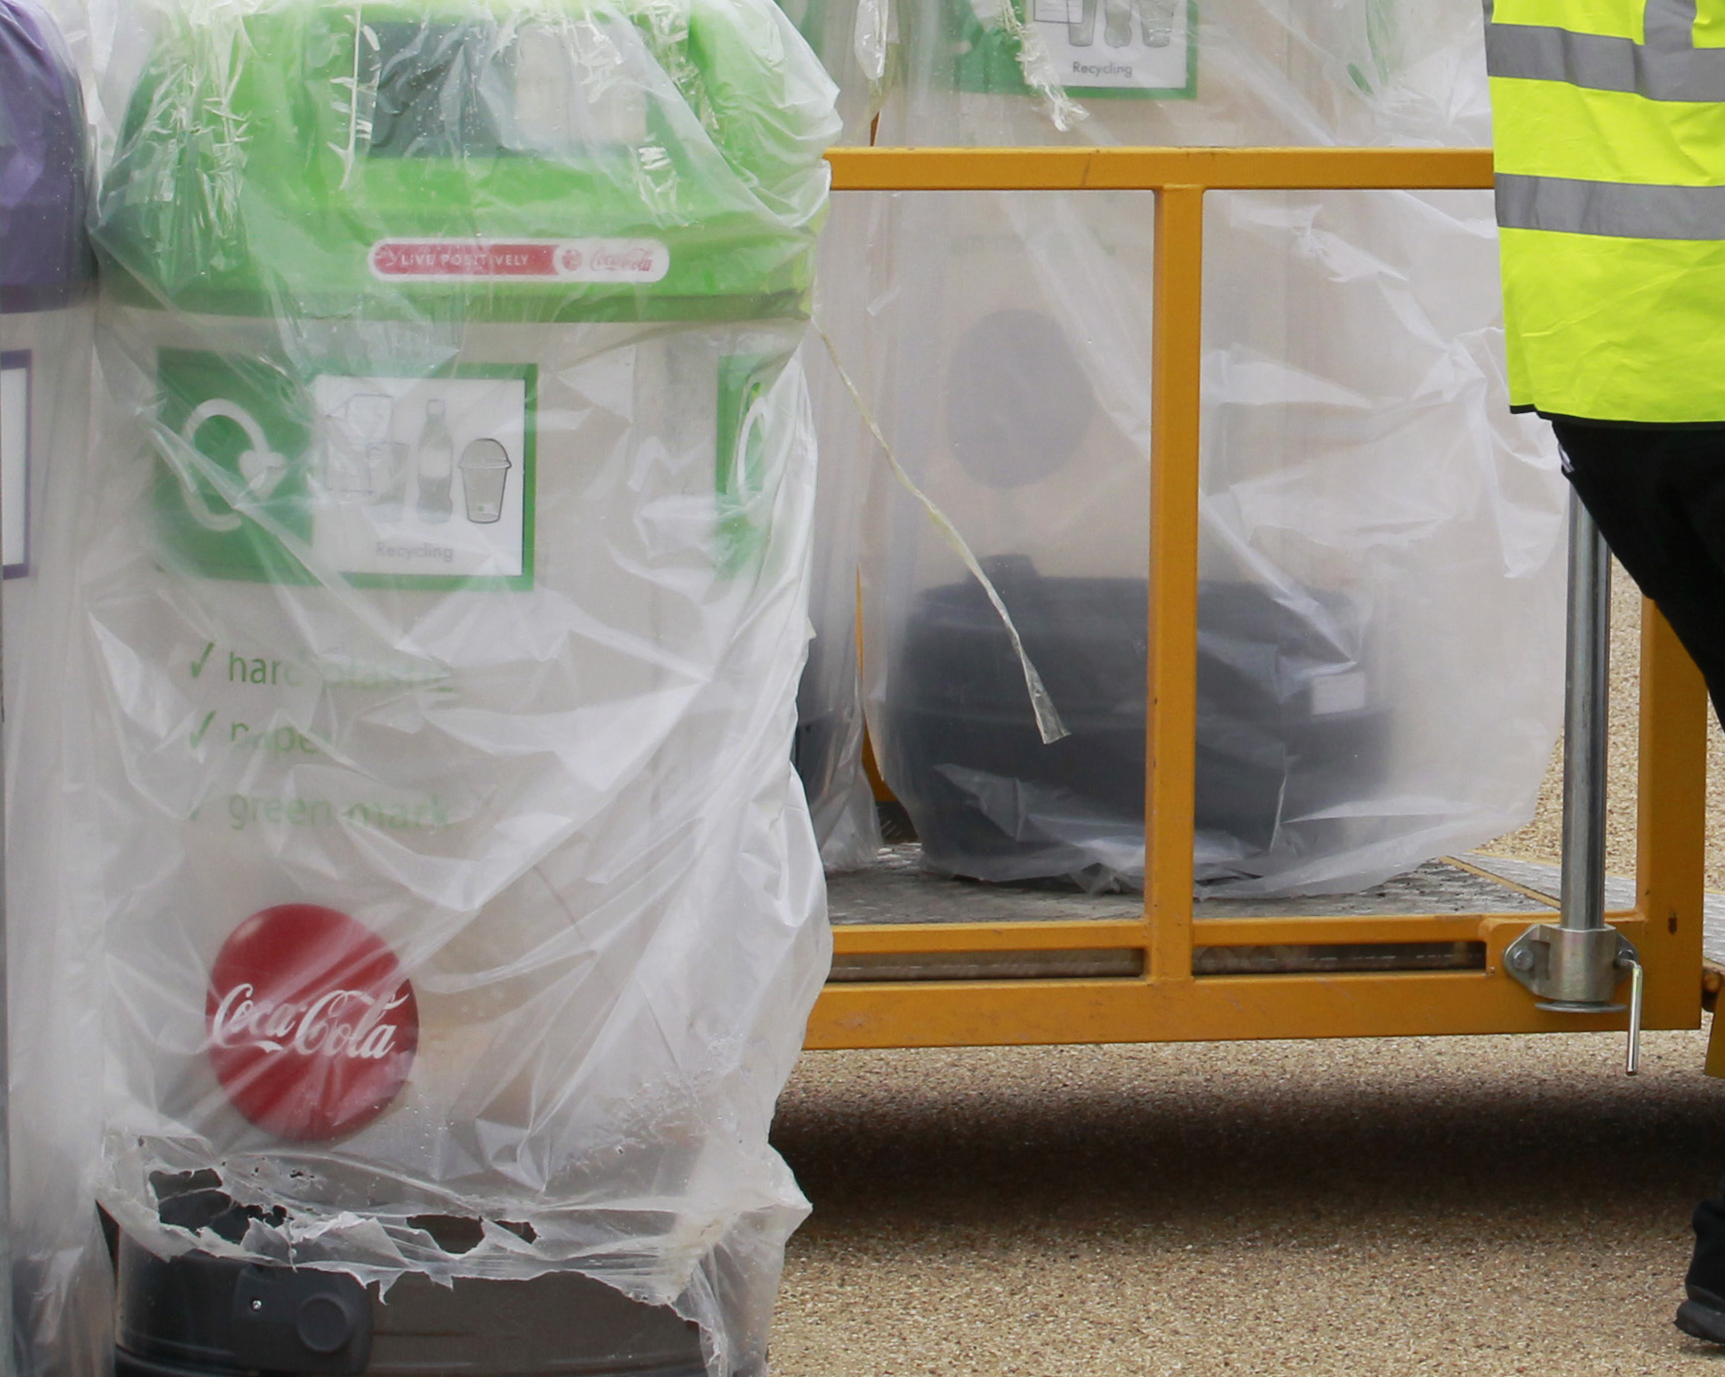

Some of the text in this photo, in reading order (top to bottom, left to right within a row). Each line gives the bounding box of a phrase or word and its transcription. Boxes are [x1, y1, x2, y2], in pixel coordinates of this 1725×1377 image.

[1072, 61, 1133, 79] Recycling
[402, 254, 530, 267] LIVE POSITIVELY
[376, 541, 454, 563] Recycling
[229, 794, 332, 831] green
